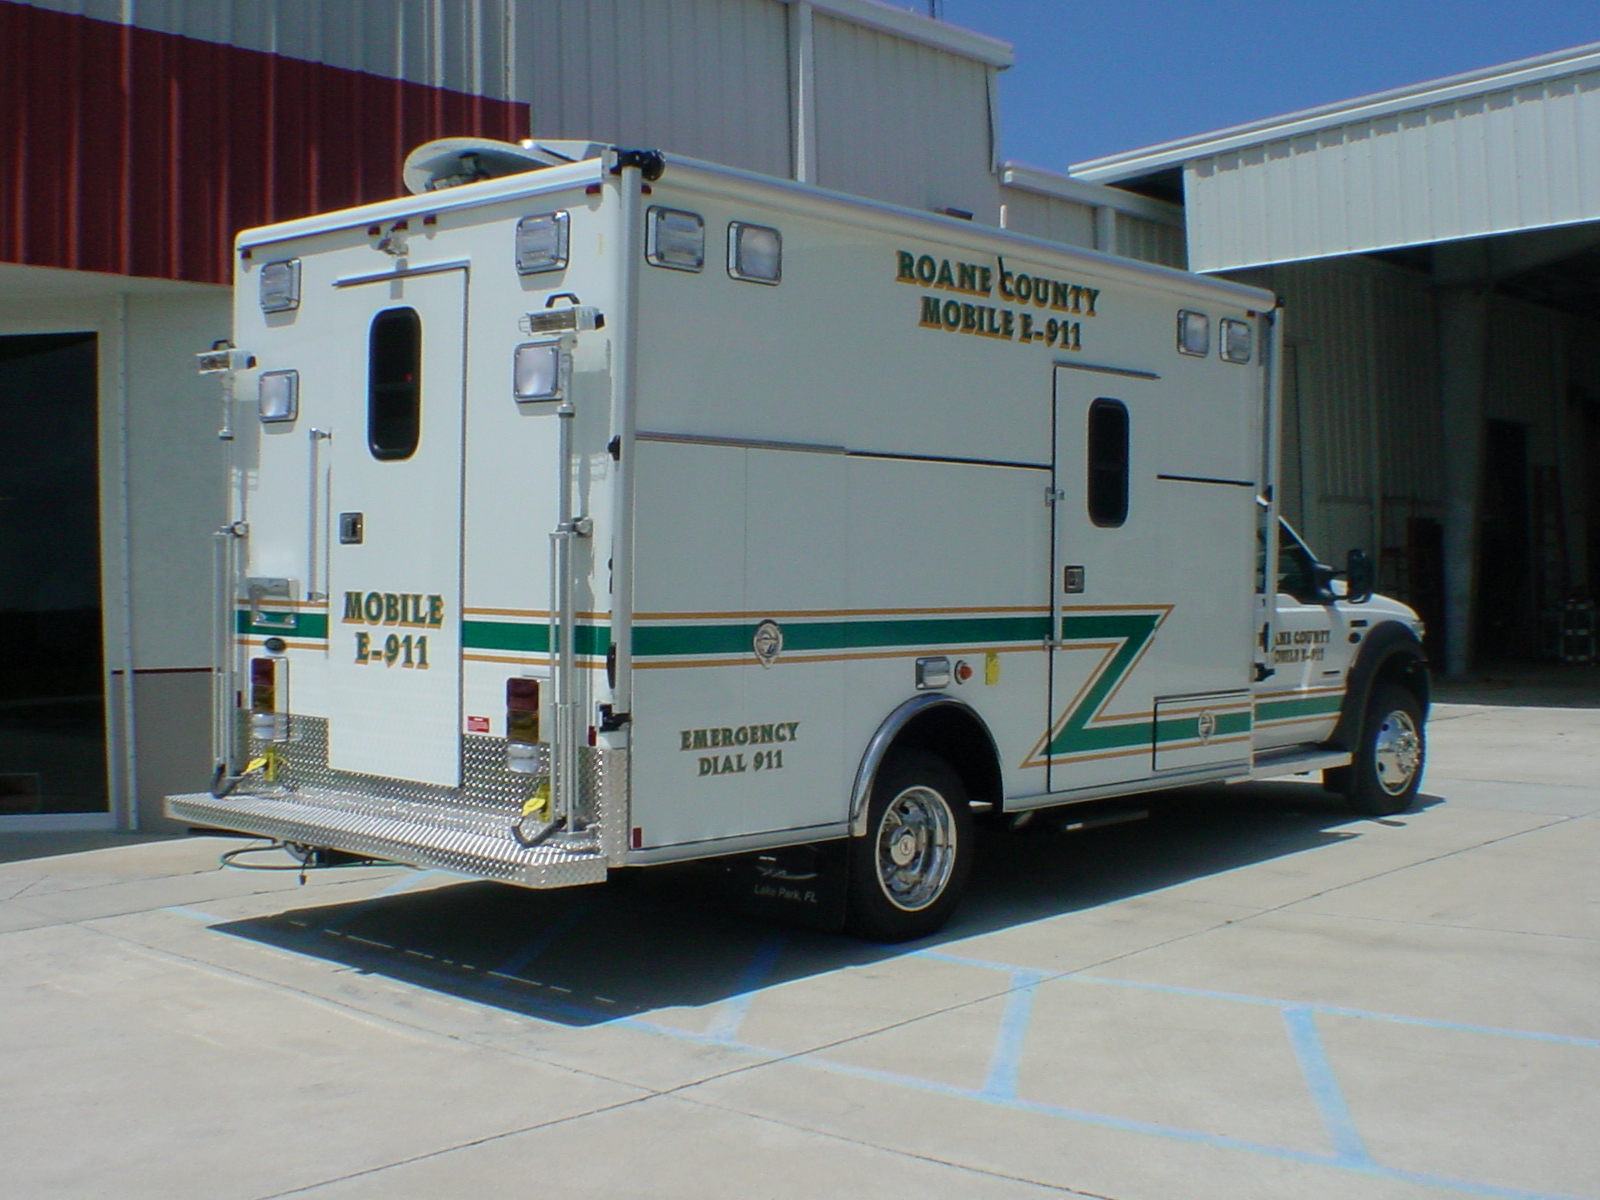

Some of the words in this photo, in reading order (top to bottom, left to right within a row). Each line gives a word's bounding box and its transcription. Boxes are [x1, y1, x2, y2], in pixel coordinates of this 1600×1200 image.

[896, 250, 992, 298] ROANE
[998, 269, 1100, 317] COUNTY
[918, 296, 1015, 341] MOBILE
[1018, 312, 1081, 351] E-911
[342, 591, 444, 629] MOBILE
[354, 631, 429, 669] E-911
[680, 722, 800, 751] EMERGENCY
[698, 753, 748, 776] DIAL
[753, 749, 783, 772] 911
